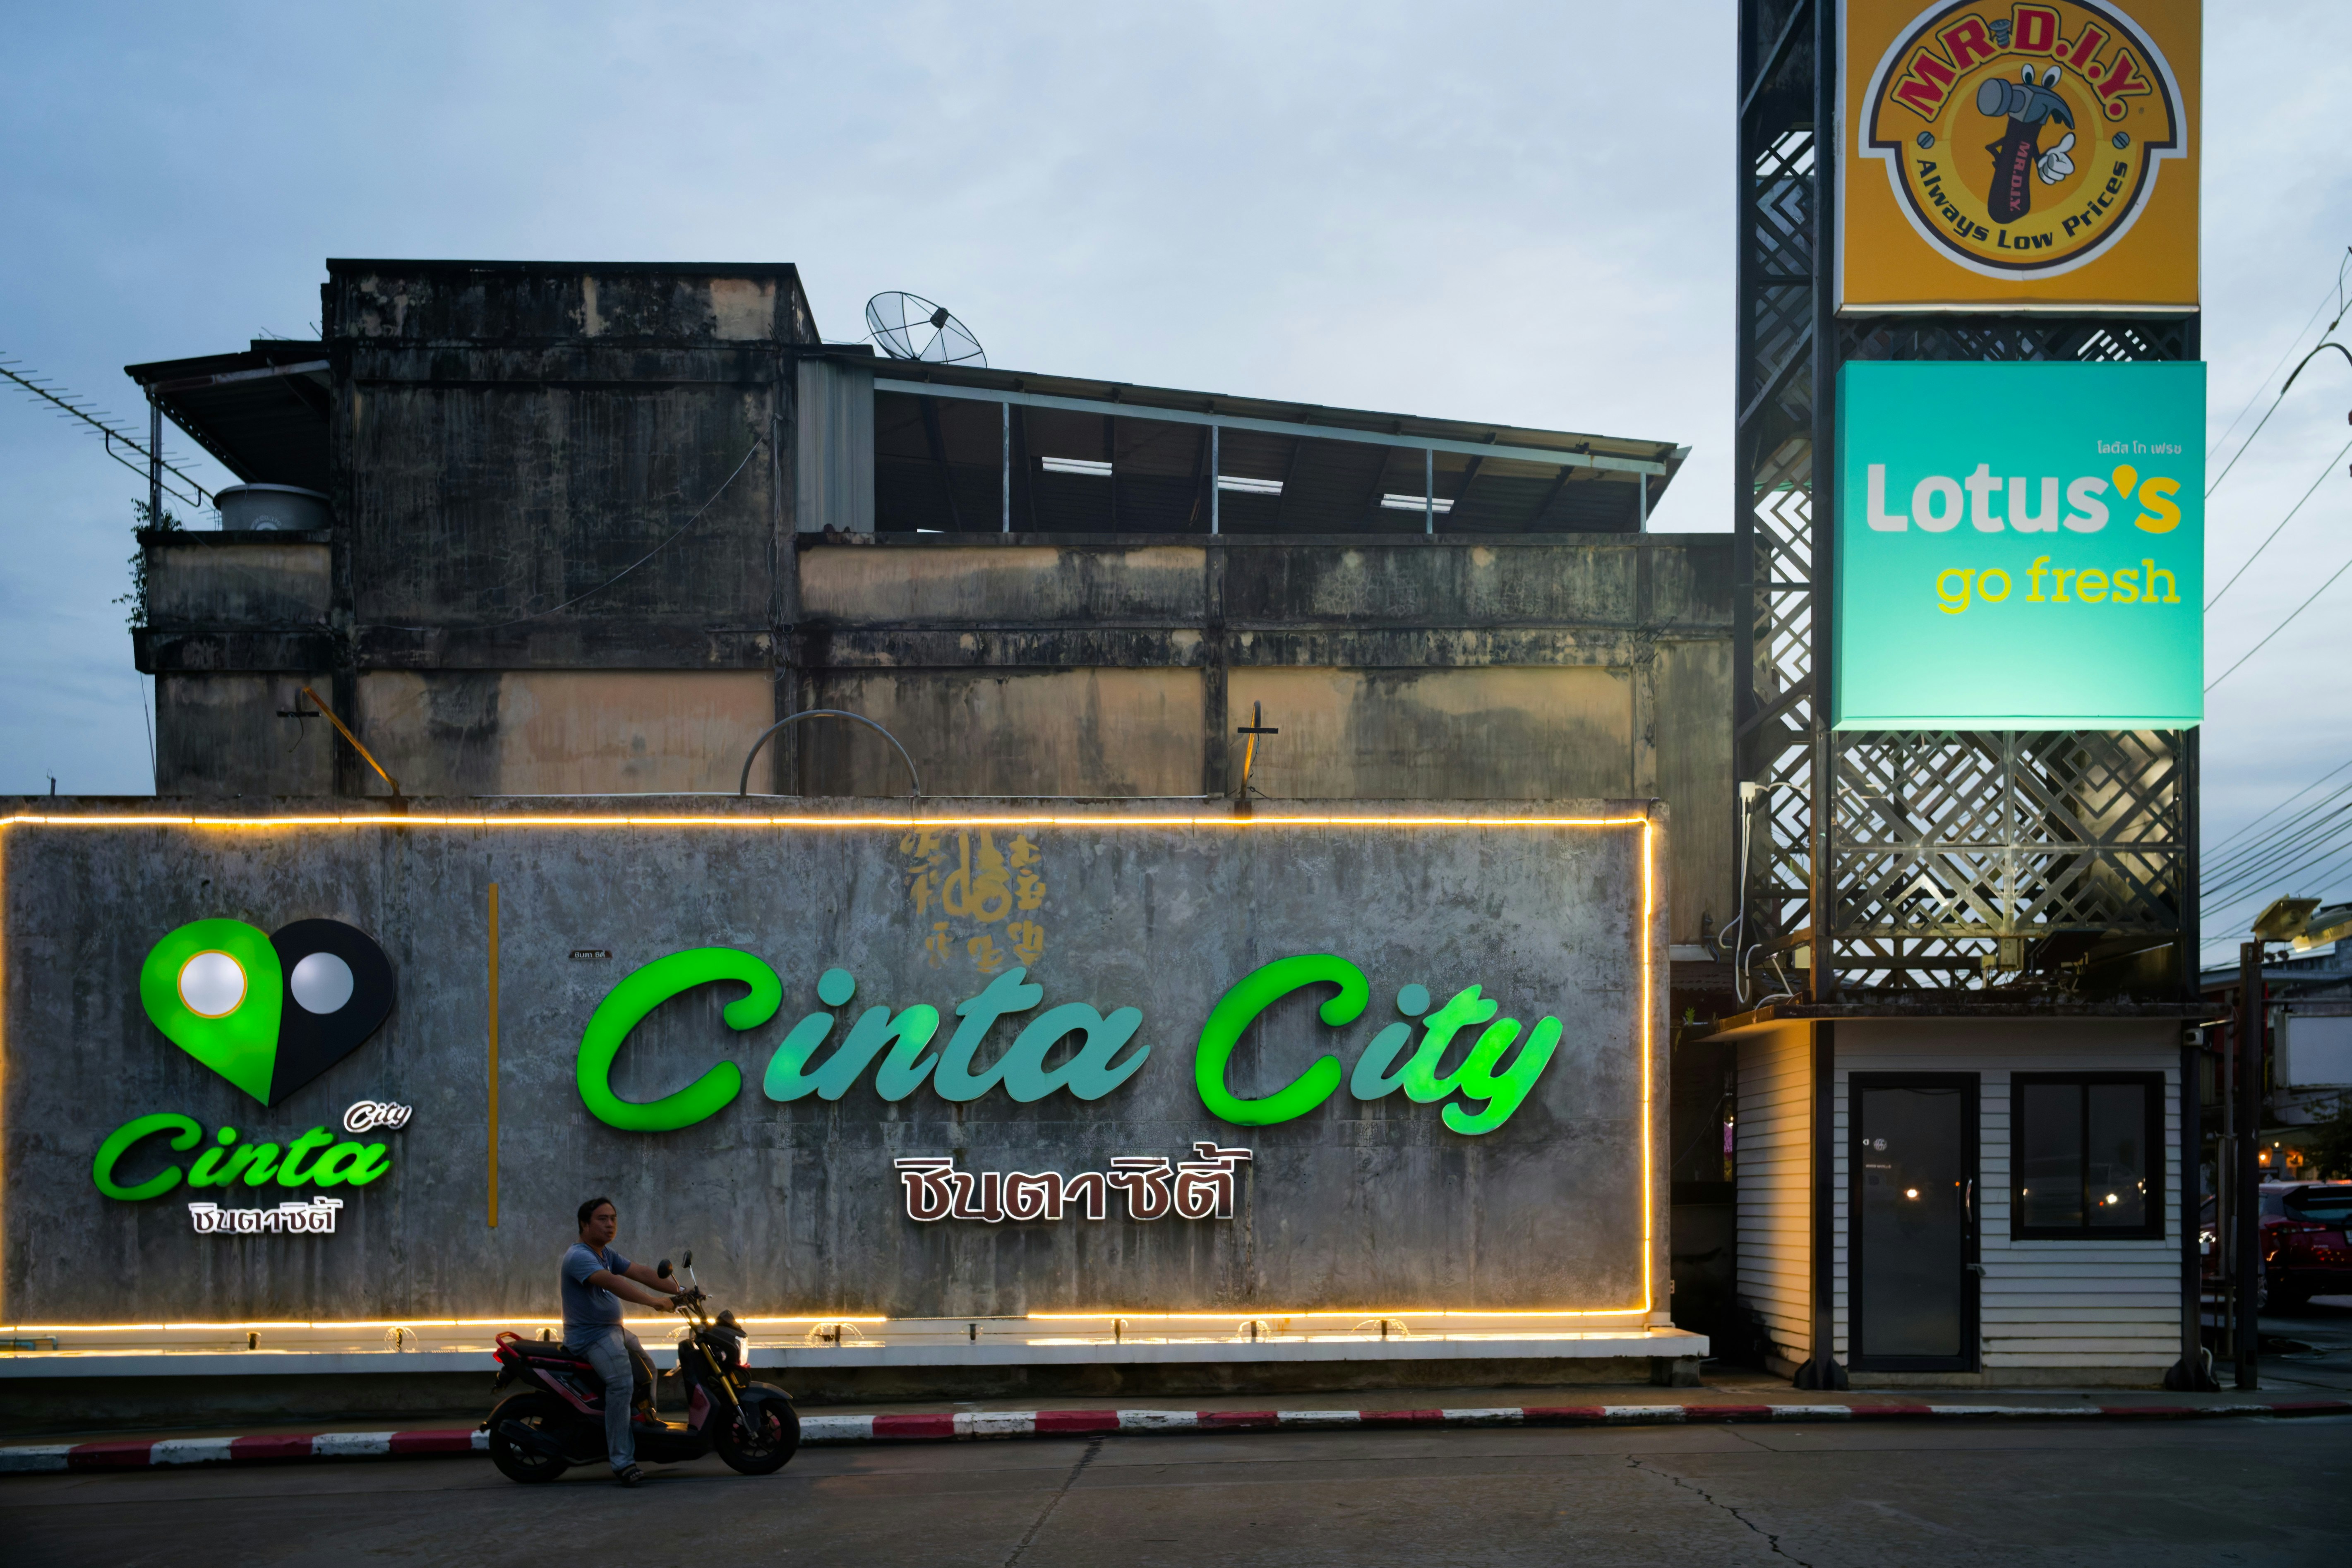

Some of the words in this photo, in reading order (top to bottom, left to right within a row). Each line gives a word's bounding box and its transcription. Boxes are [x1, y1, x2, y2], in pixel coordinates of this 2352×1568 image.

[1917, 159, 1989, 241] Always
[1997, 229, 2052, 249] Low
[2062, 161, 2128, 237] Prices
[2097, 440, 2129, 454] โลตัส
[2133, 440, 2146, 454] โก
[2151, 442, 2182, 455] เฟรช
[1867, 463, 2182, 534] Lotus's
[1936, 568, 2012, 614] go
[2026, 555, 2181, 603] fresh
[576, 947, 1151, 1133] Cinta
[1195, 953, 1563, 1135] City
[344, 1100, 413, 1133] City
[93, 1112, 393, 1201] Cinta
